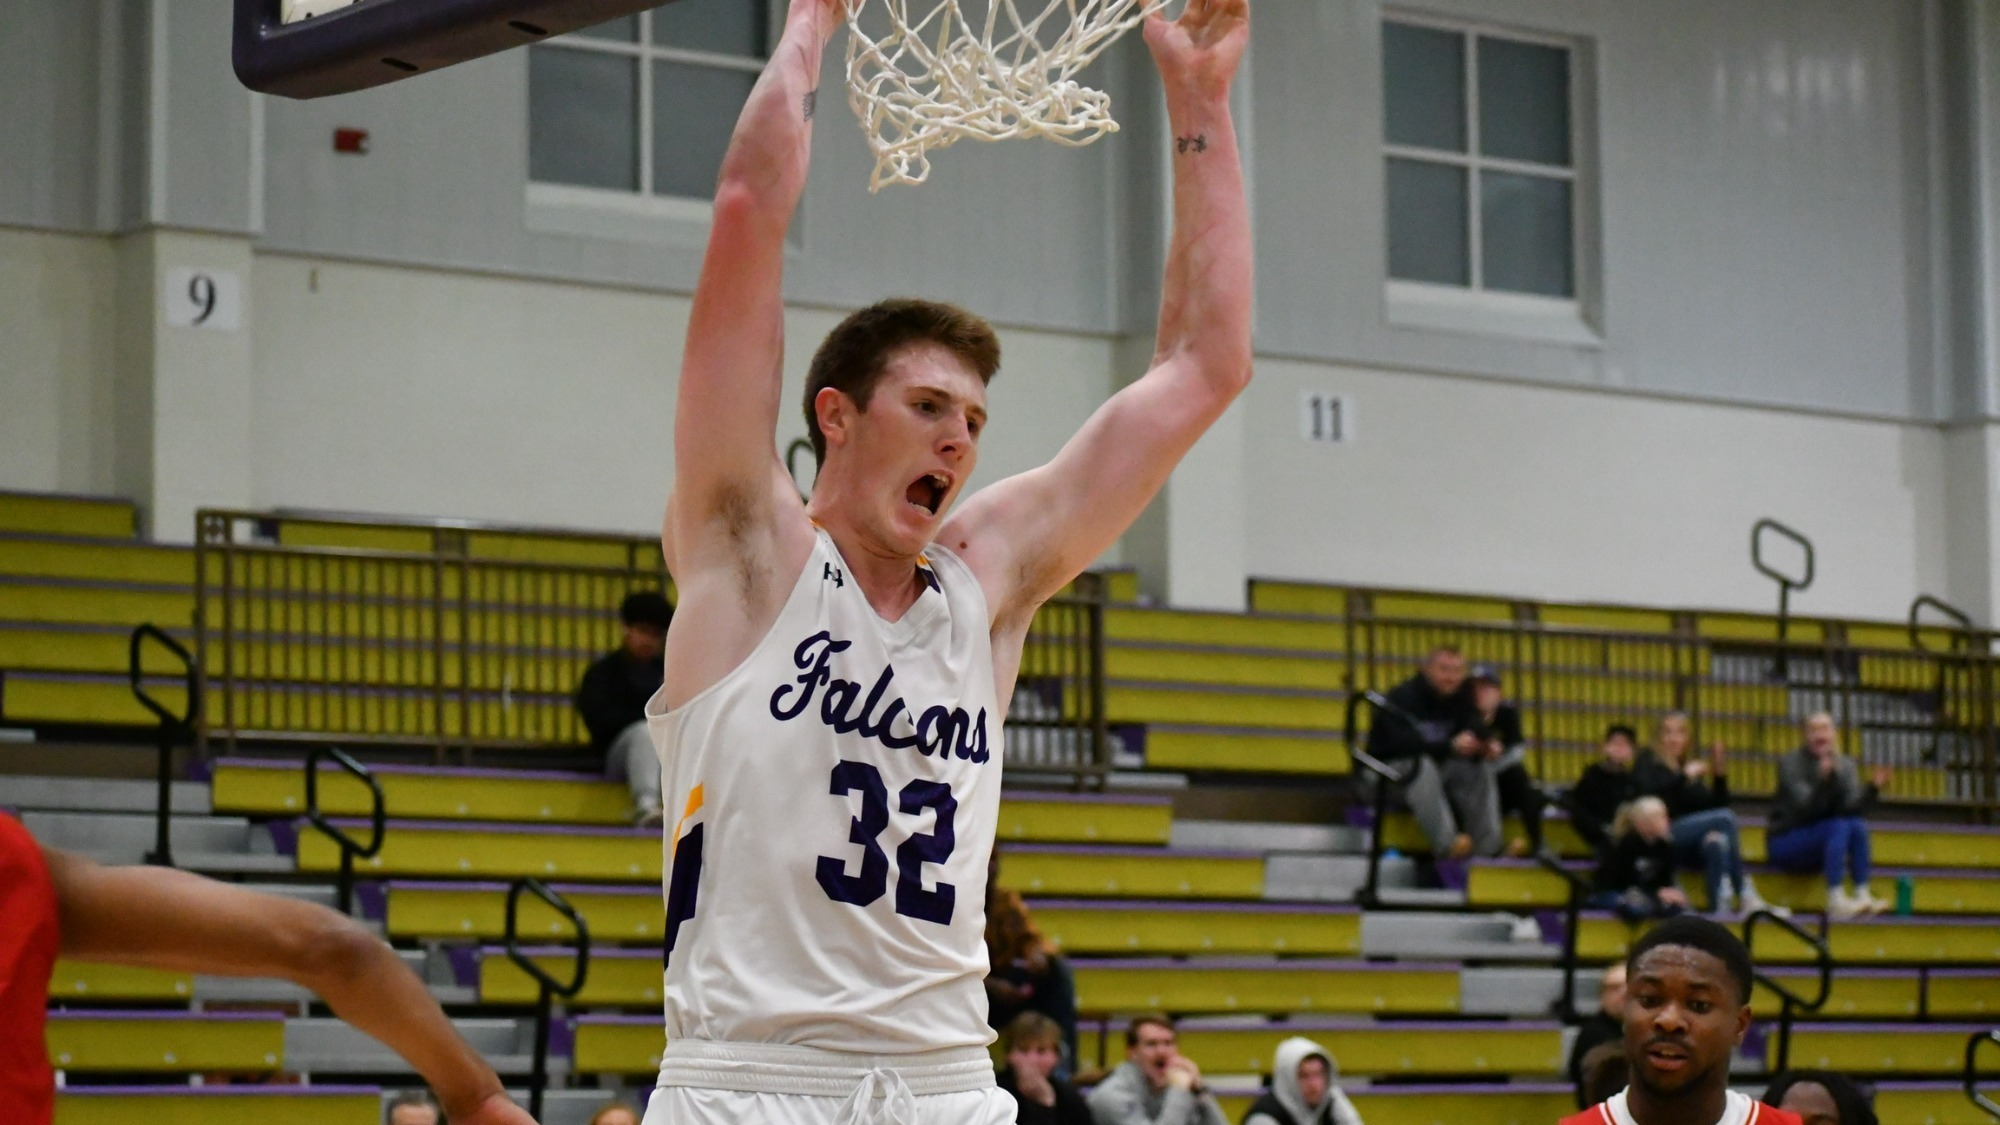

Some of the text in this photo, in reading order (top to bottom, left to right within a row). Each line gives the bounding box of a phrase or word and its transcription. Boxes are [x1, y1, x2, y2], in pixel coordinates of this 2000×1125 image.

[188, 273, 216, 326] 9
[1309, 396, 1342, 441] 11
[769, 630, 990, 765] Falcons
[815, 759, 958, 926] 32
